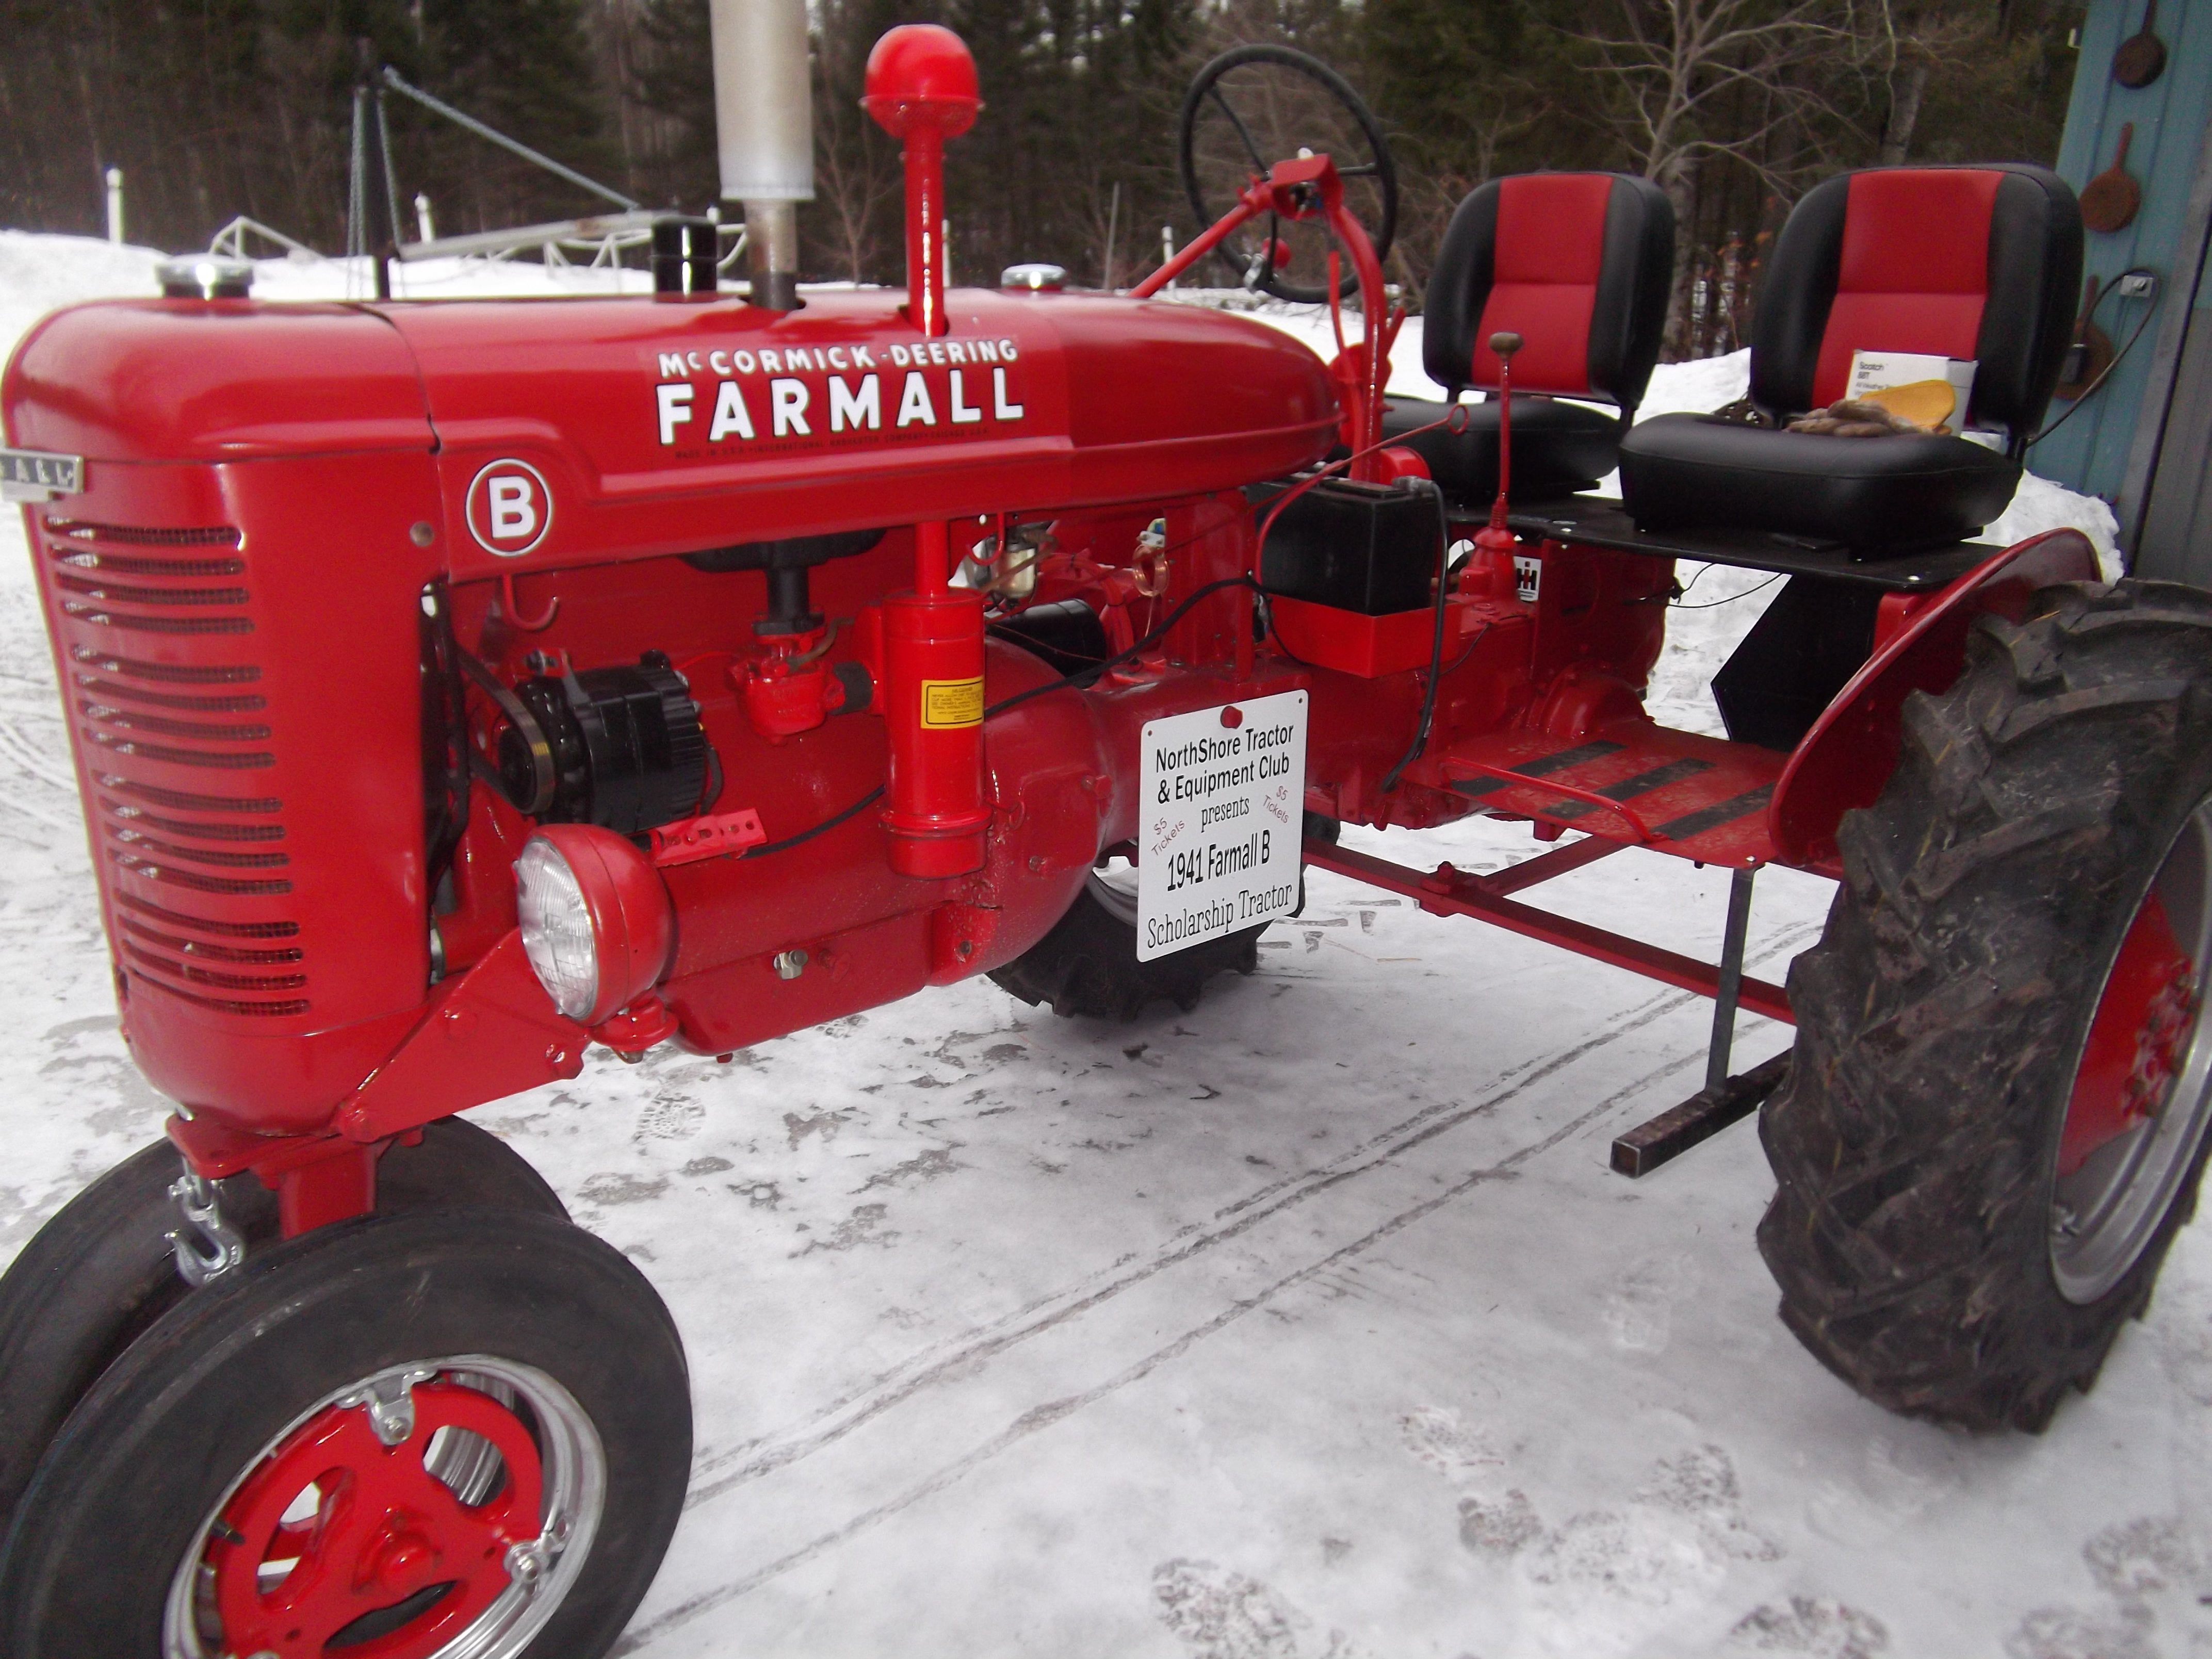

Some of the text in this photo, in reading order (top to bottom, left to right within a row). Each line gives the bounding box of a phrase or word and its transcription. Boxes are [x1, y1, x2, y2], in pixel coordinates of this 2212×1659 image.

[656, 367, 1024, 446] FARMALL
[488, 476, 535, 539] B
[1156, 724, 1294, 773] NorthShore Tractor
[1158, 752, 1290, 804] & Equipment Club
[1276, 785, 1289, 801] $5
[1153, 817, 1167, 835] $5
[1201, 796, 1249, 833] presents
[1263, 794, 1289, 824] Tickets
[1151, 820, 1185, 856] Tickets
[1167, 829, 1270, 891] 1941 Farmall B
[1148, 884, 1292, 949] Scholarship Tractor
